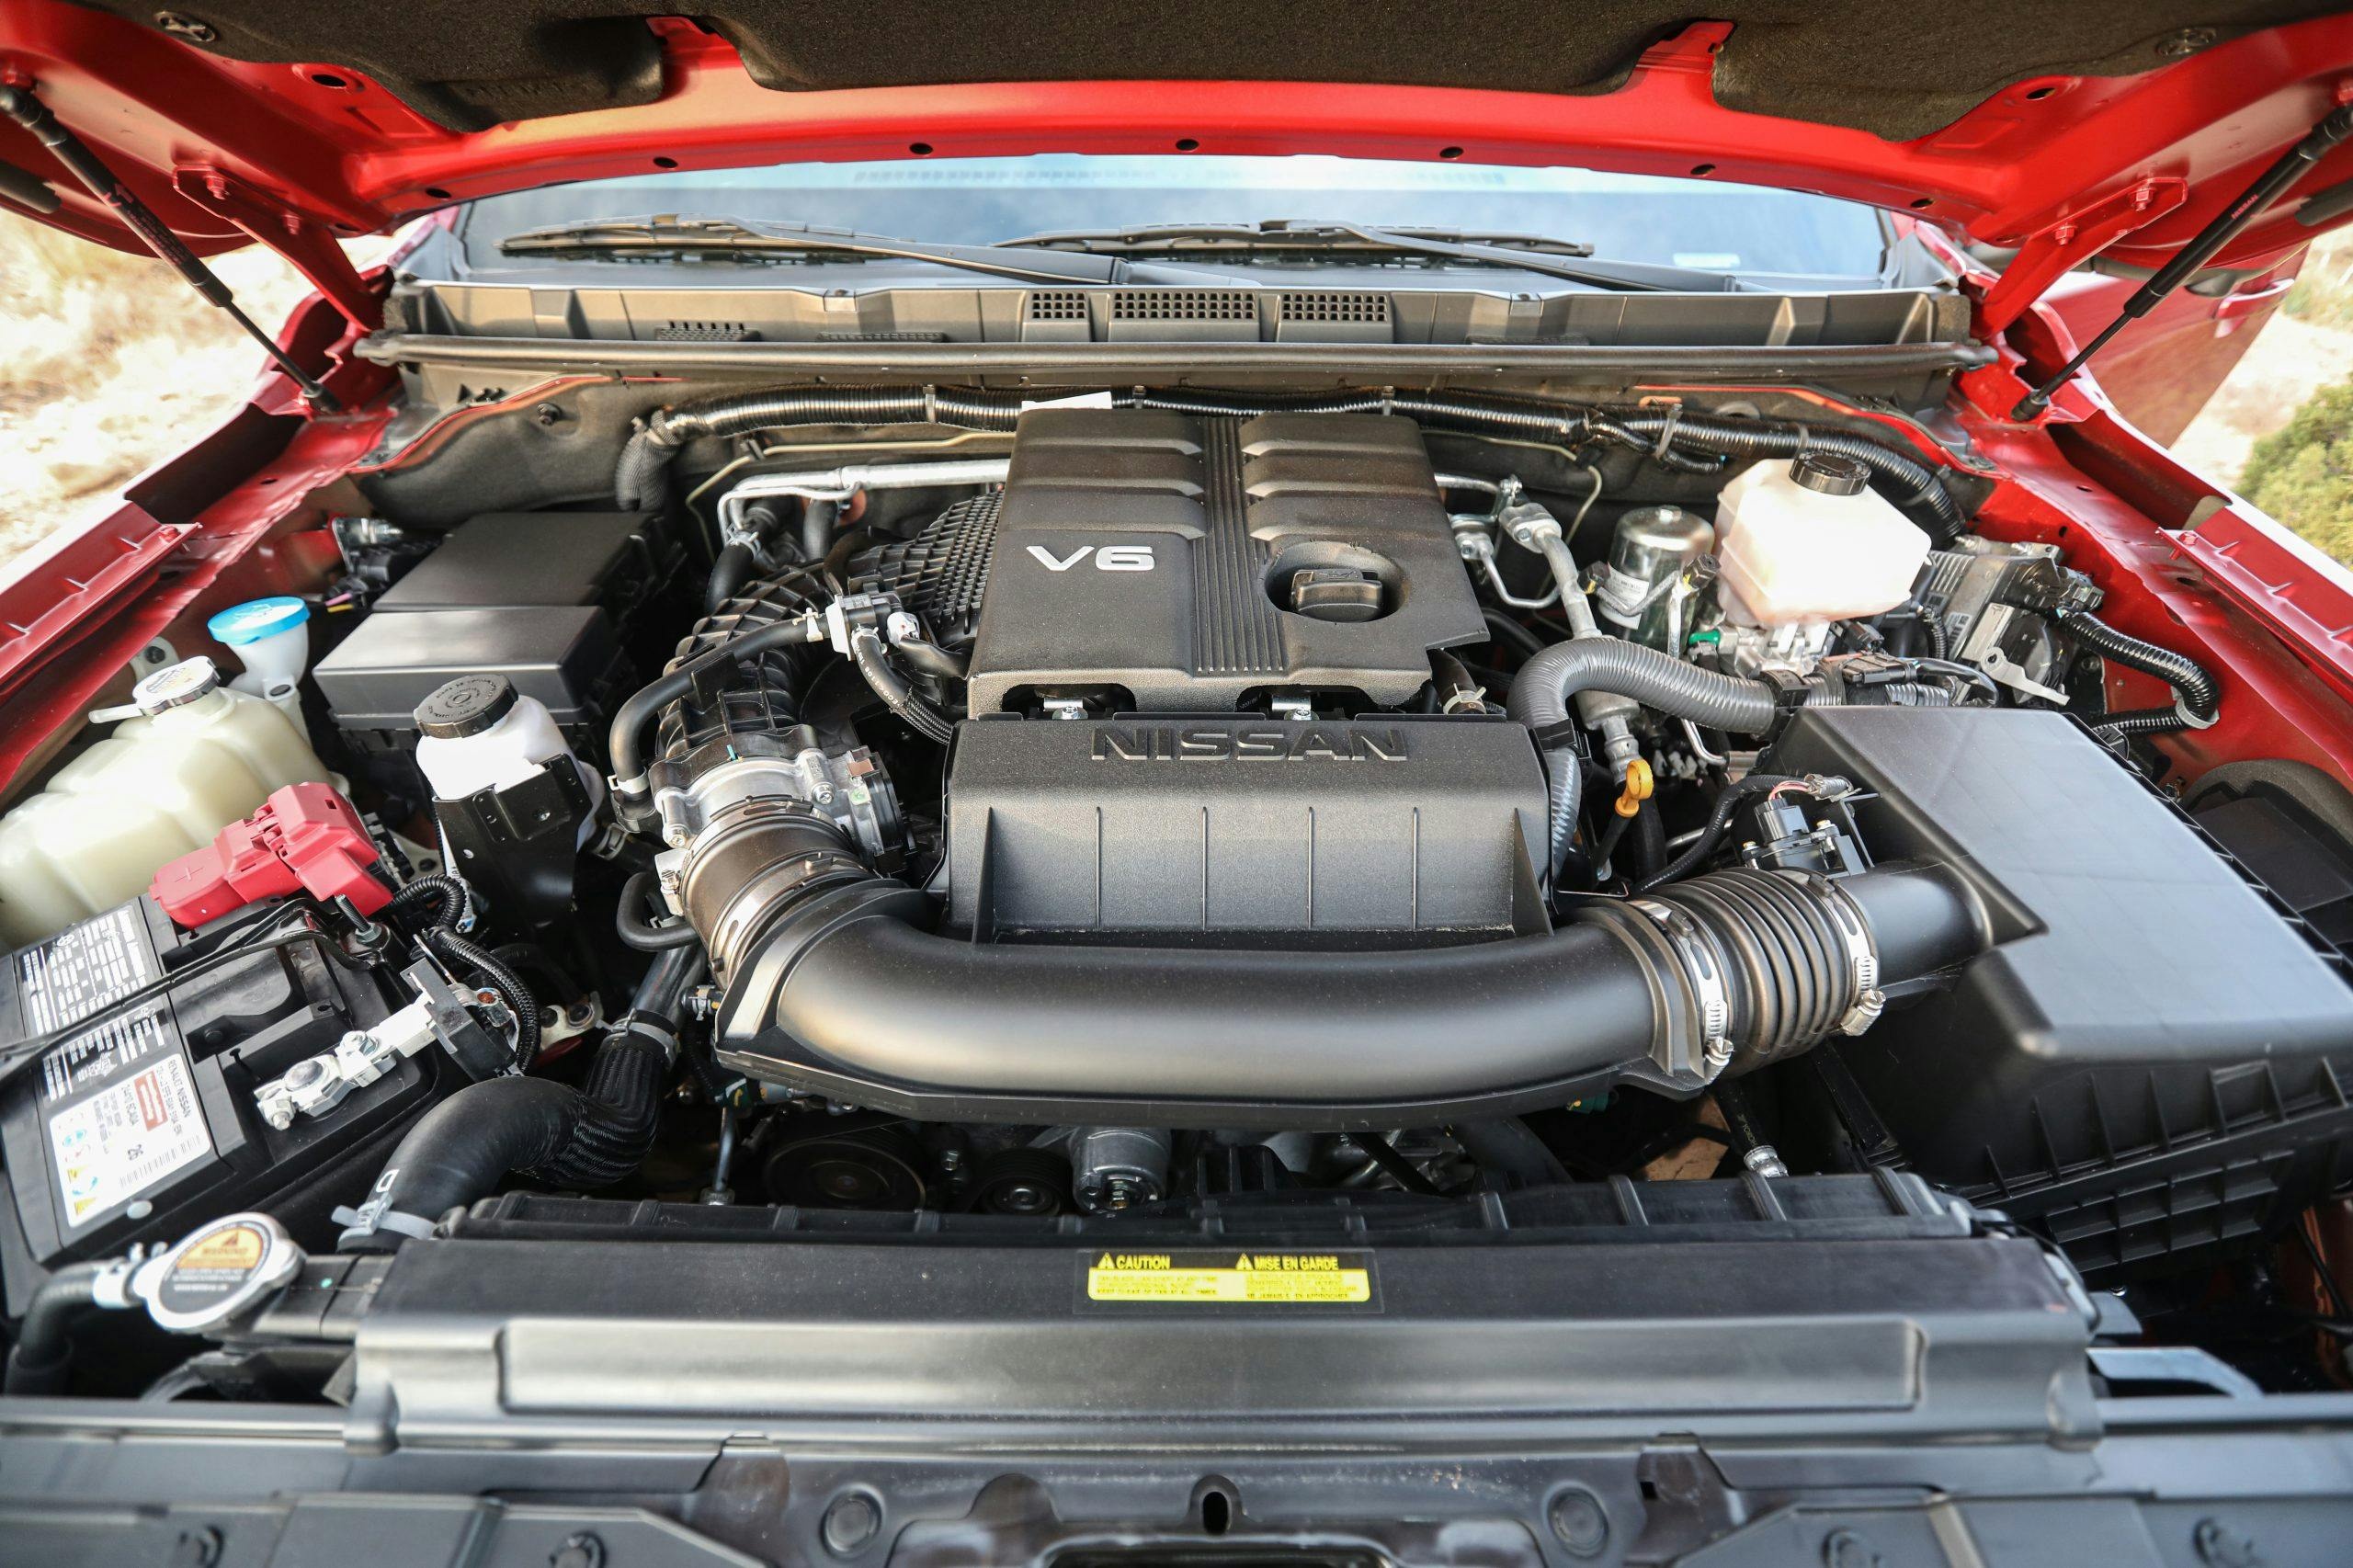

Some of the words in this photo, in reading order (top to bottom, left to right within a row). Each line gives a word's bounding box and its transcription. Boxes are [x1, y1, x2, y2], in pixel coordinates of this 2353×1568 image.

[2232, 194, 2258, 220] NISSAN
[1026, 545, 1155, 571] V6
[1091, 728, 1407, 761] NISSAN
[176, 1087, 191, 1118] NISSAN
[1116, 1255, 1171, 1269] CAUTION
[1253, 1256, 1281, 1270] MISE
[1282, 1256, 1299, 1270] EN
[1299, 1256, 1339, 1270] GARDE
